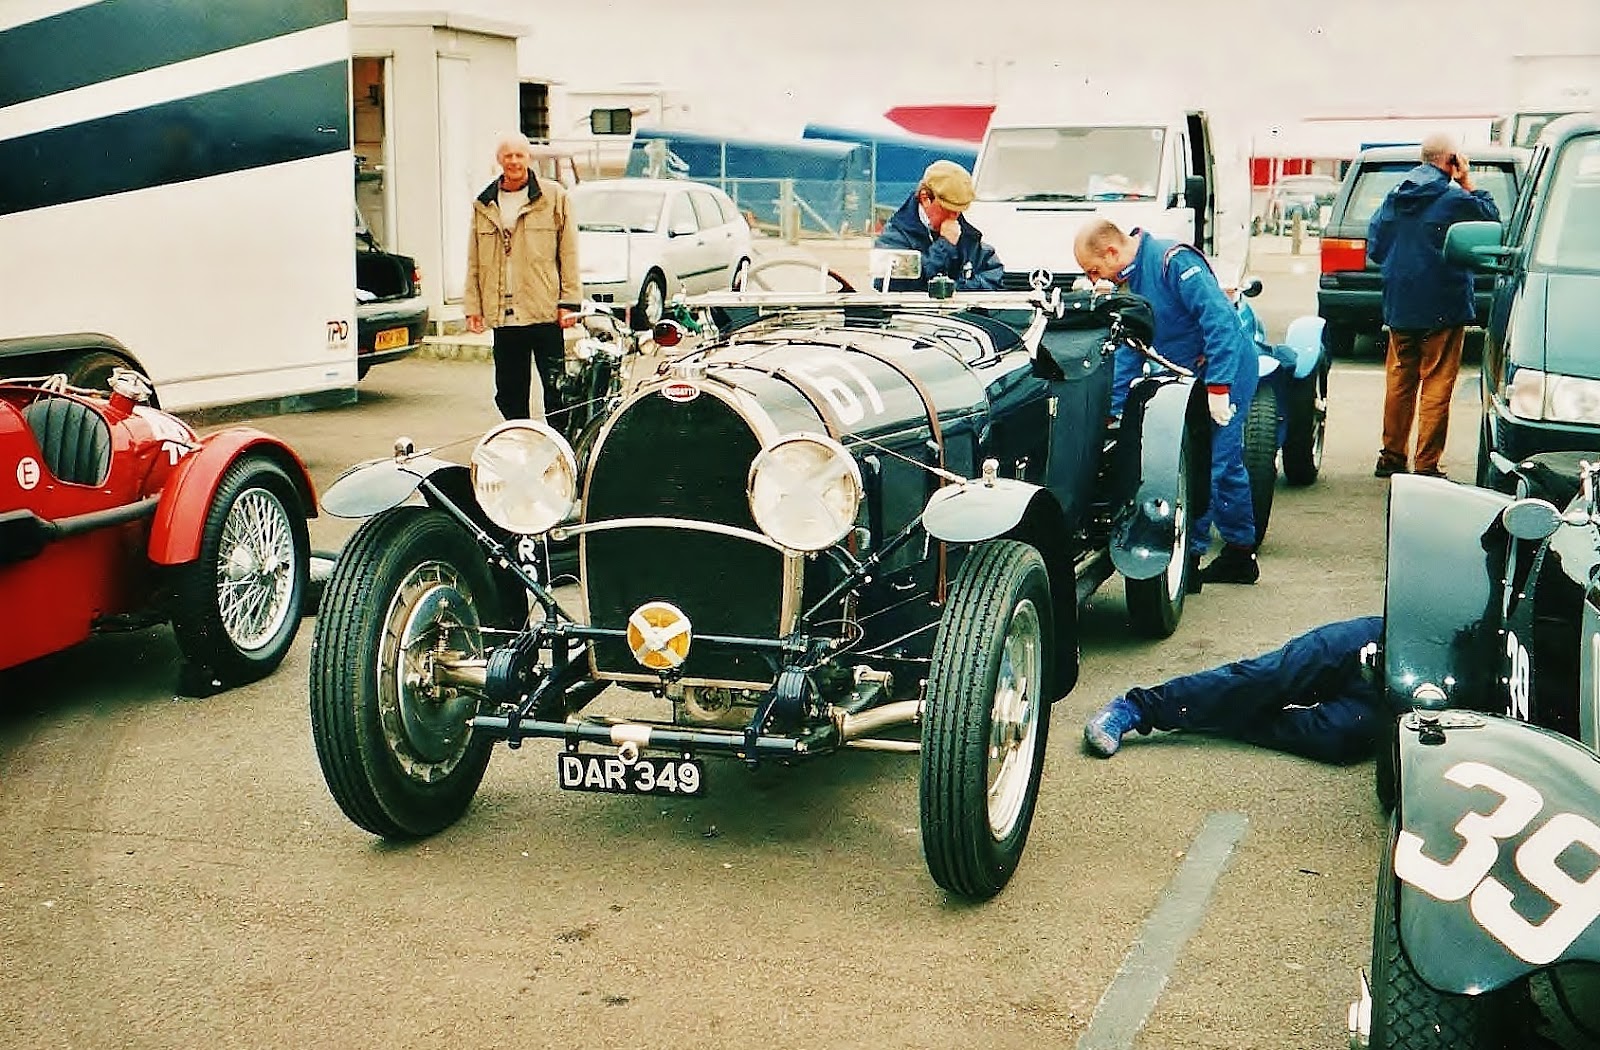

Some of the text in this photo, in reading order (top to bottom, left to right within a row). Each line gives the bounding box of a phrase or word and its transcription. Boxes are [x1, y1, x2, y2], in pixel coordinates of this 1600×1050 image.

[22, 461, 34, 485] E
[562, 756, 700, 793] DAR 349
[1394, 762, 1600, 964] 39
